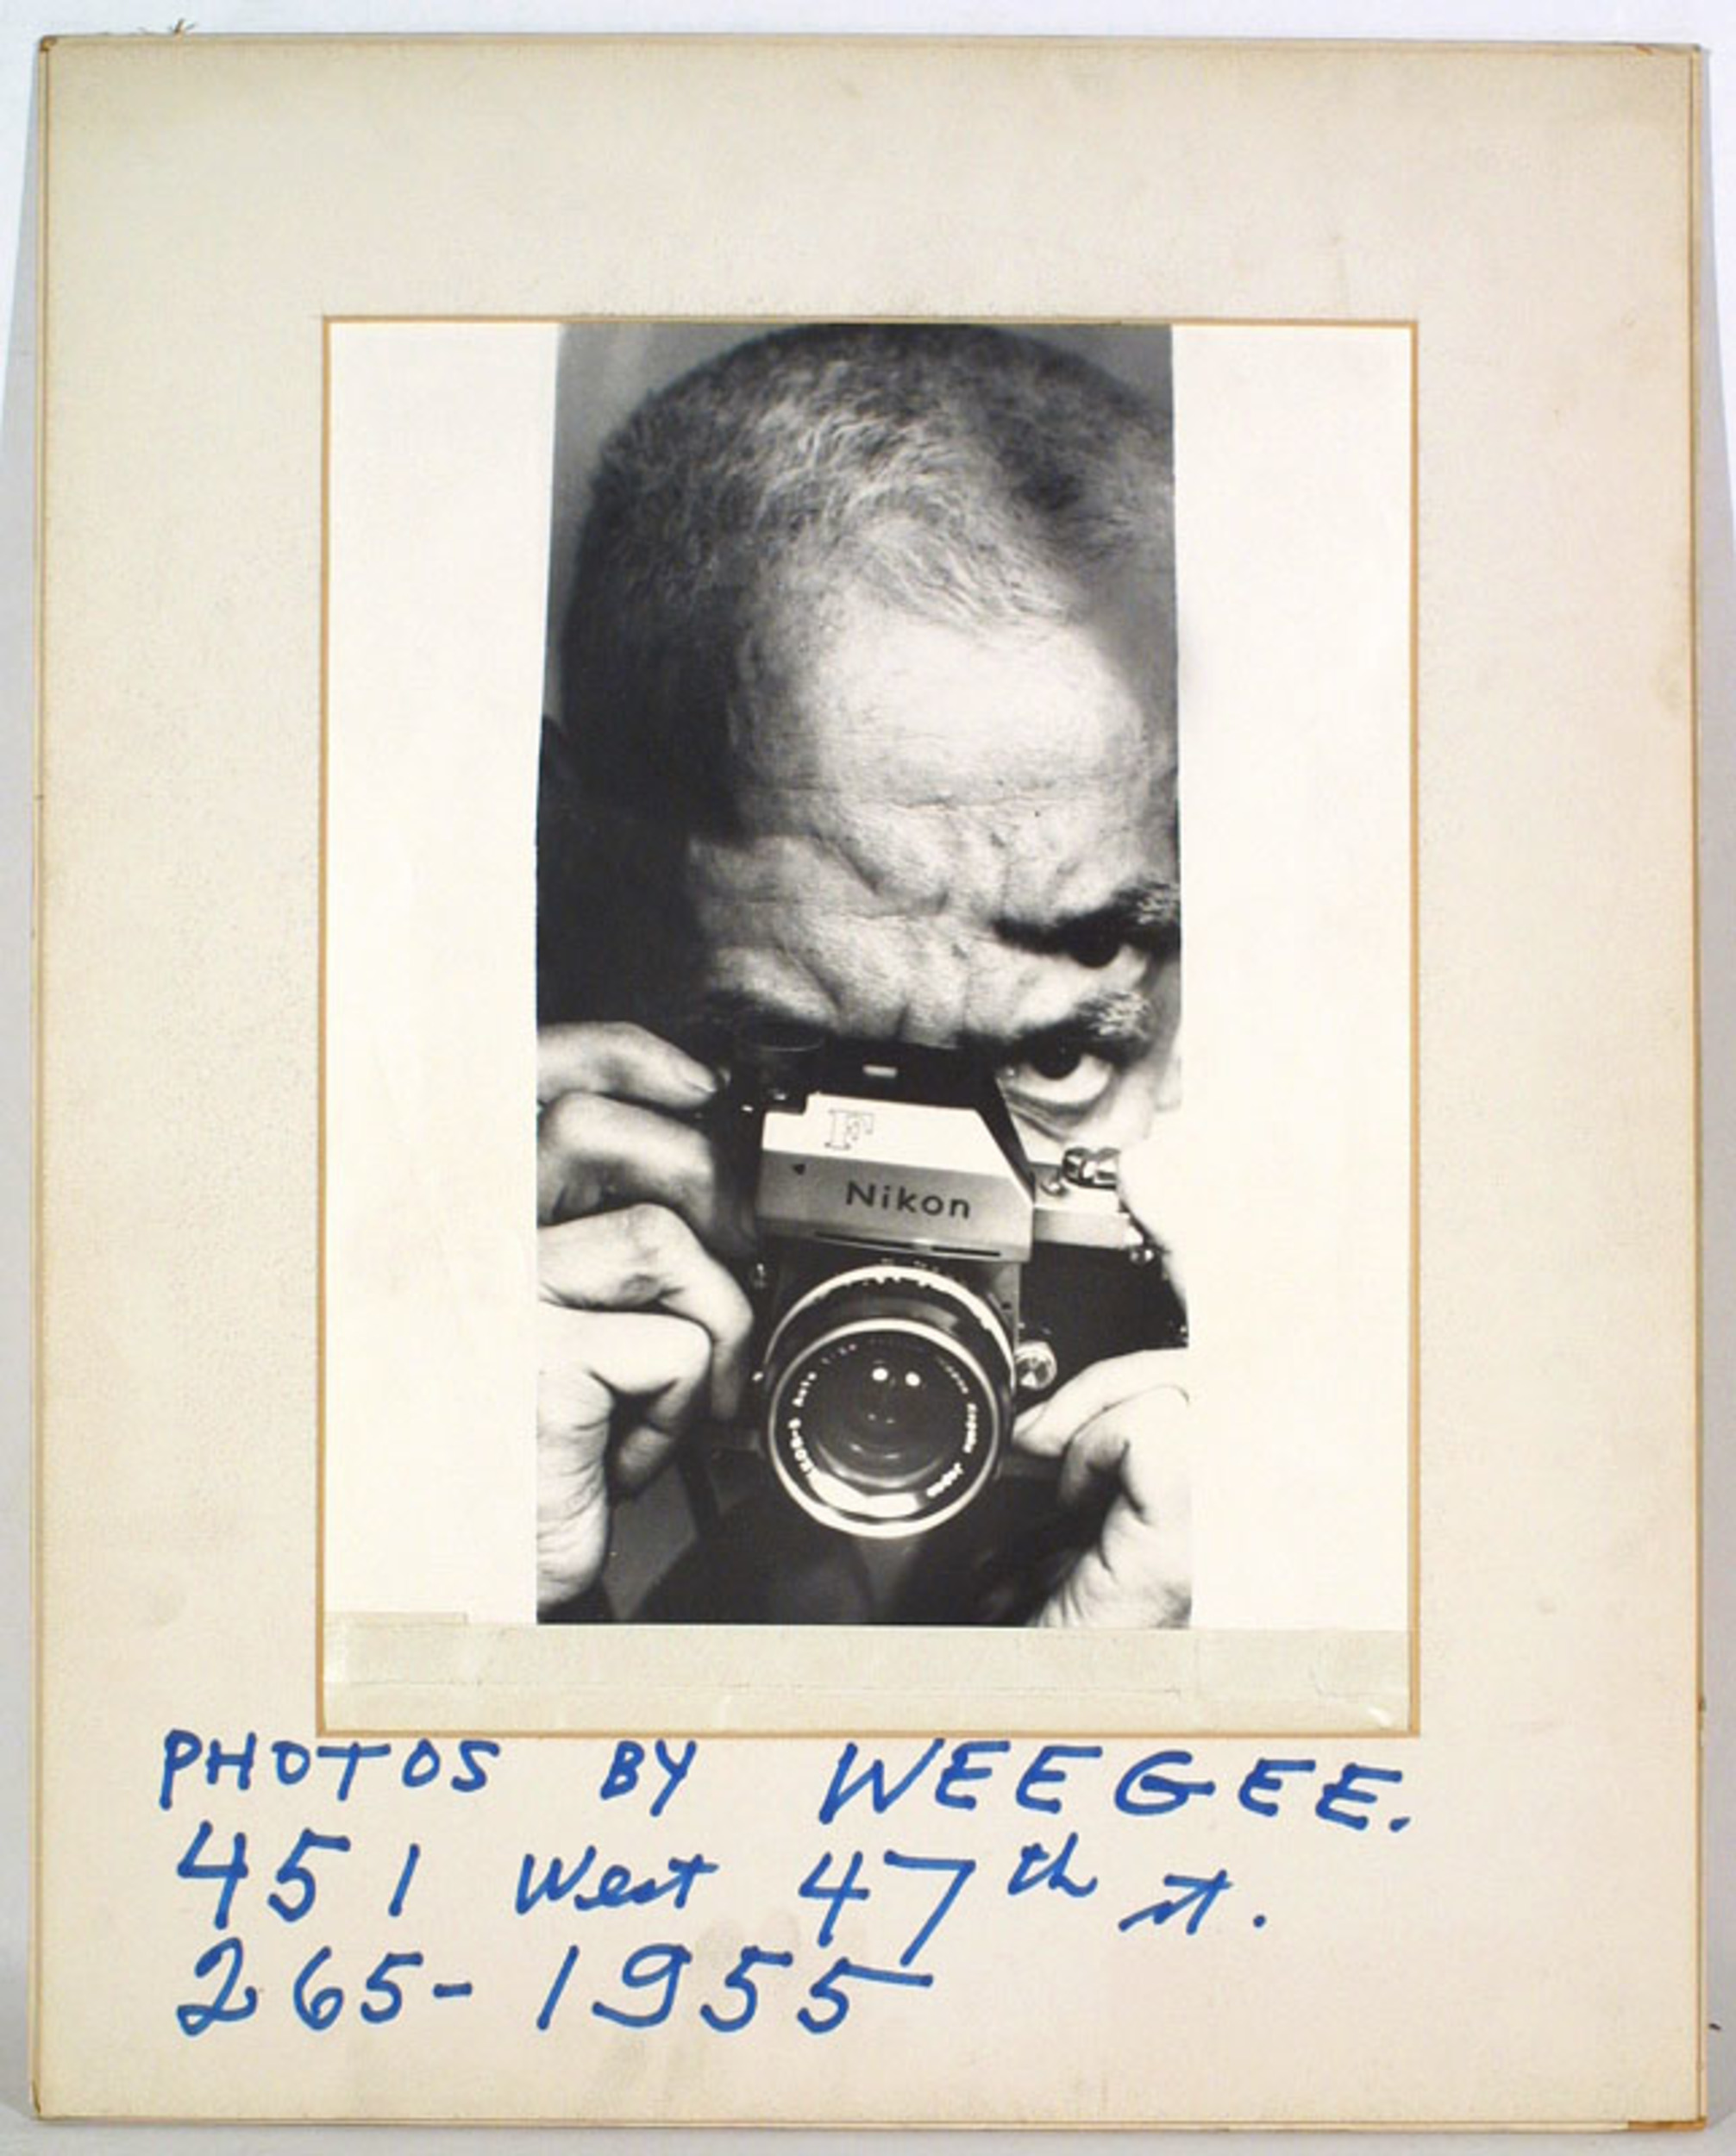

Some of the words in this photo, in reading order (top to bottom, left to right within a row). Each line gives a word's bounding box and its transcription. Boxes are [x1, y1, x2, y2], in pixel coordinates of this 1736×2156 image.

[824, 1108, 874, 1151] F
[844, 1179, 972, 1220] Nikon
[159, 1728, 501, 1811] PHOTOS
[599, 1740, 697, 1818] BY
[818, 1738, 1413, 1833] WEEGEE.
[176, 1820, 421, 1931] 451
[515, 1844, 718, 1915] West
